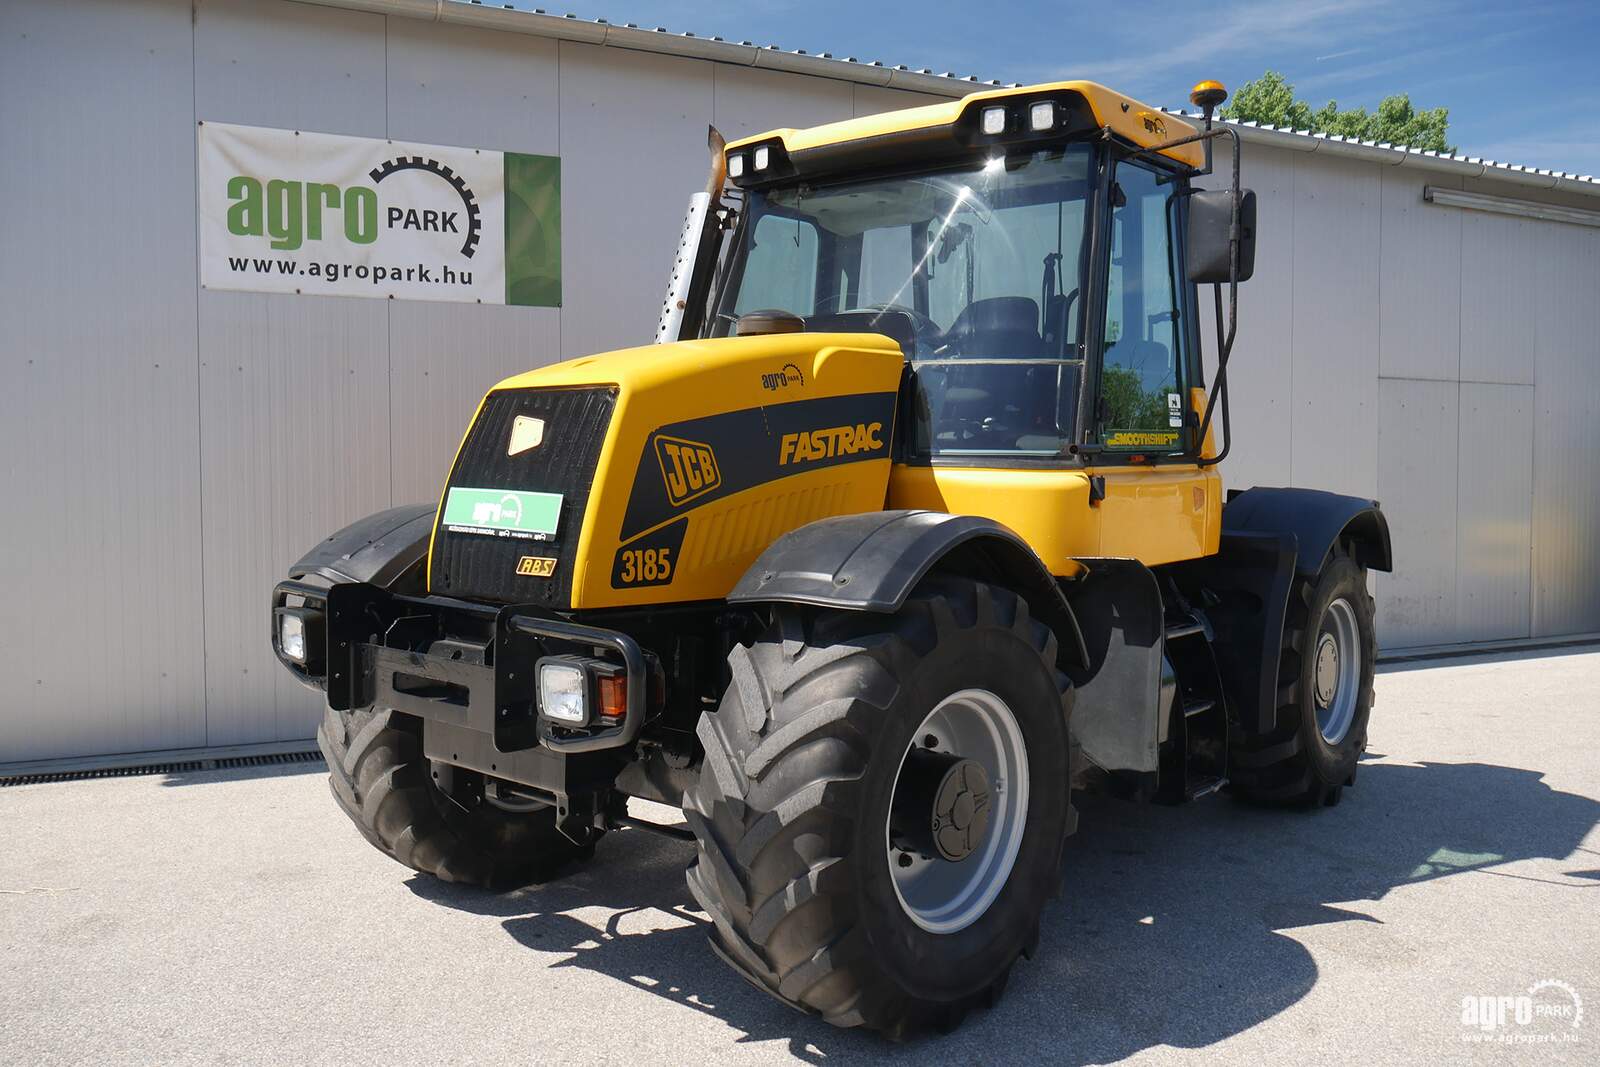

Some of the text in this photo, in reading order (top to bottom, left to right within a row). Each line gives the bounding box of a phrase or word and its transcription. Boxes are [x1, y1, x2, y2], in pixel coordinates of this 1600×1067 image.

[227, 176, 458, 251] agro PARK
[229, 257, 472, 285] www.agropark.hu
[761, 372, 788, 391] agro
[779, 422, 883, 465] FASTRAC
[664, 443, 715, 498] JCB
[521, 558, 552, 574] ABS
[621, 548, 670, 583] 3185
